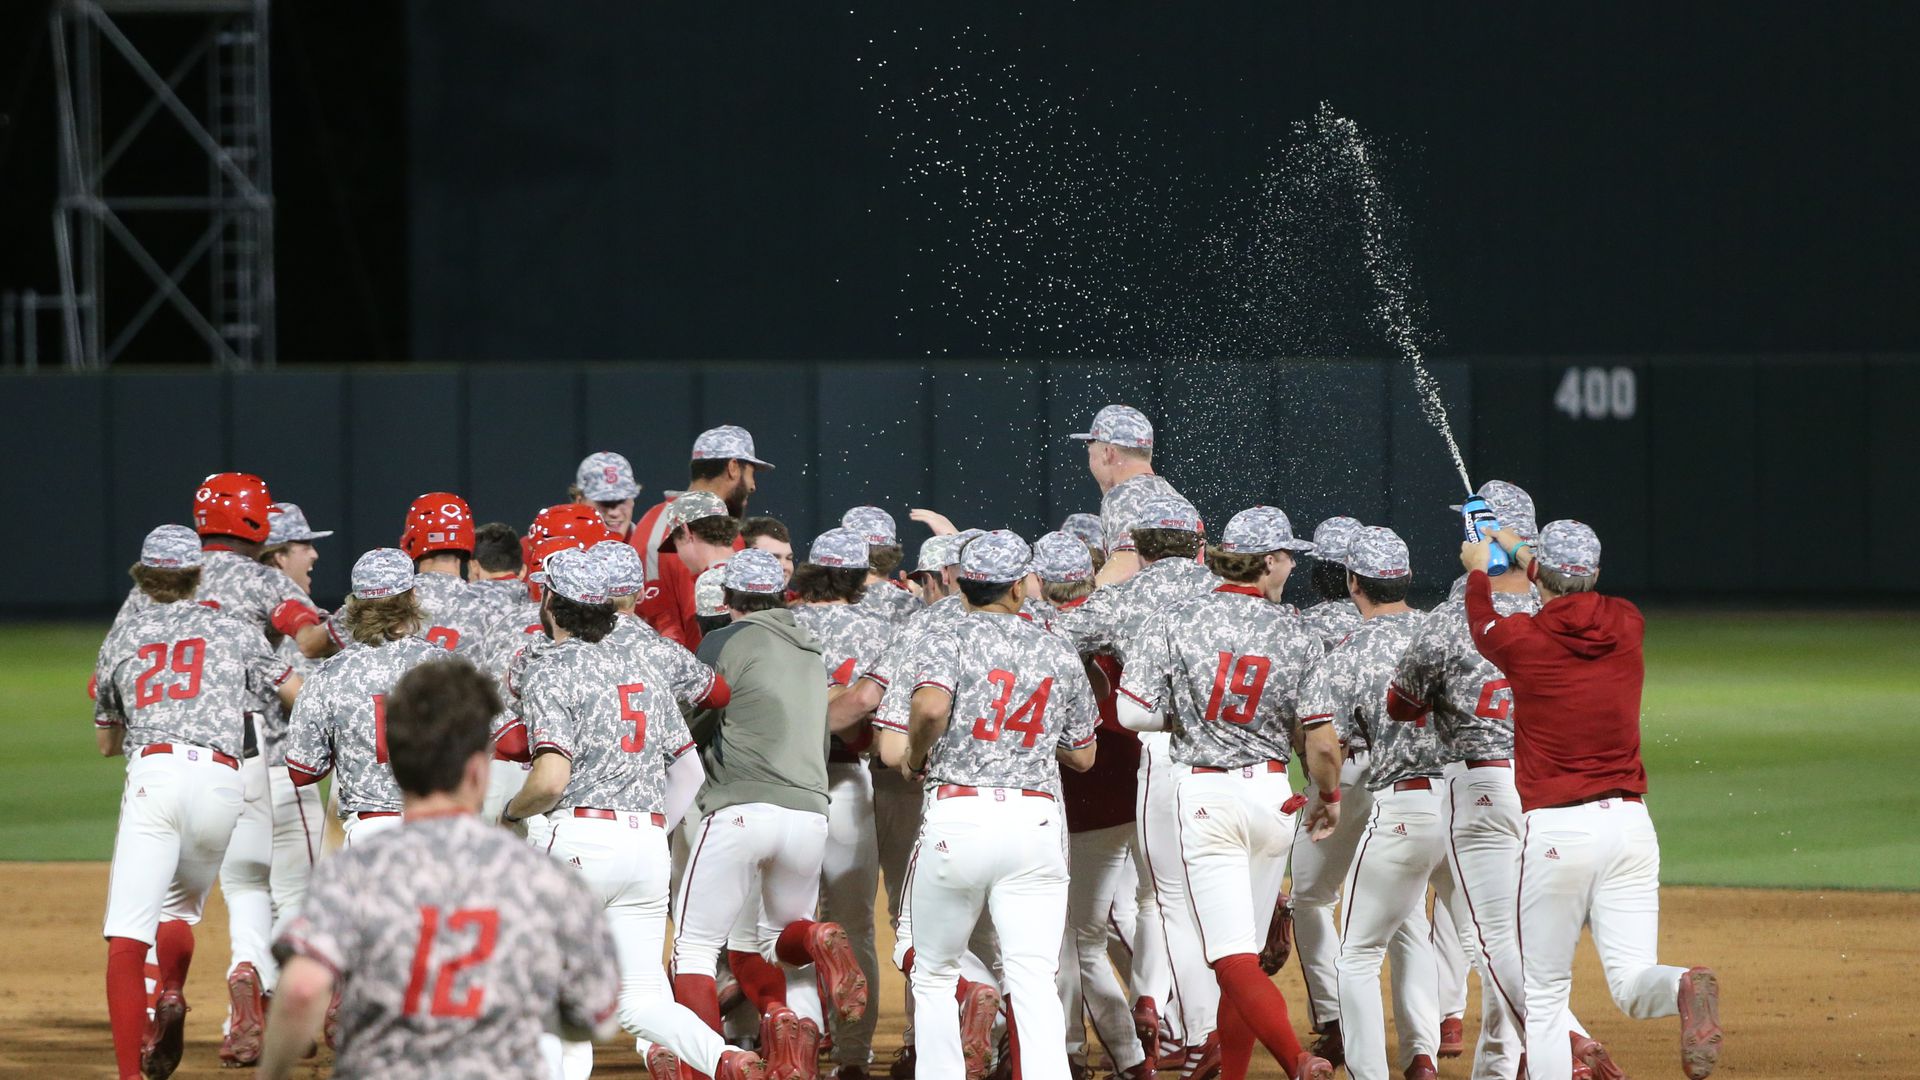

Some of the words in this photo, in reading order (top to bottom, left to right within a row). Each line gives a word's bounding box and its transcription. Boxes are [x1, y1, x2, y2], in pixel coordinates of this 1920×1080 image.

[1554, 367, 1636, 418] 400
[136, 638, 205, 709] 29
[972, 670, 1054, 749] 34
[1205, 652, 1271, 726] 19
[618, 683, 647, 754] 5
[403, 908, 498, 1020] 12
